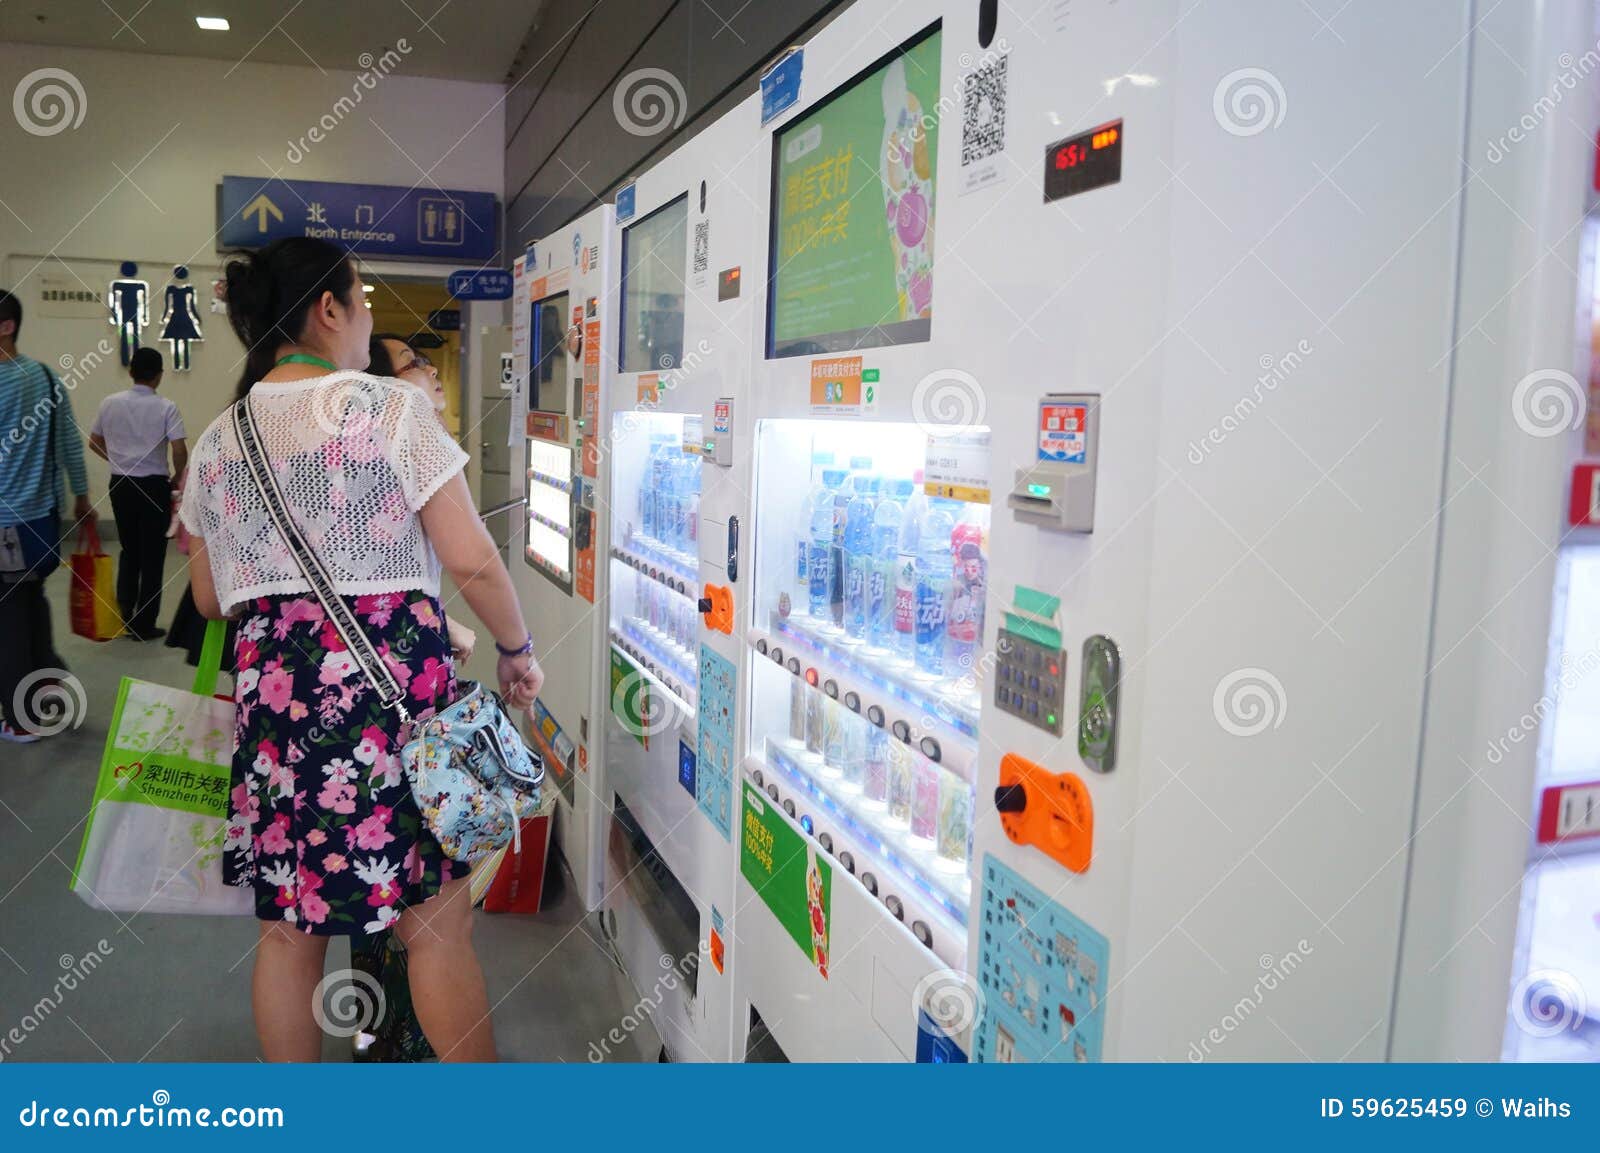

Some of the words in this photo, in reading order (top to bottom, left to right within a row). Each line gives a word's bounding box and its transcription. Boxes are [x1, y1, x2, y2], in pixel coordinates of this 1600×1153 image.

[305, 227, 337, 240] North
[341, 229, 396, 242] Entrance
[144, 765, 228, 795] 深圳市关爱
[141, 782, 197, 803] Shenzhen
